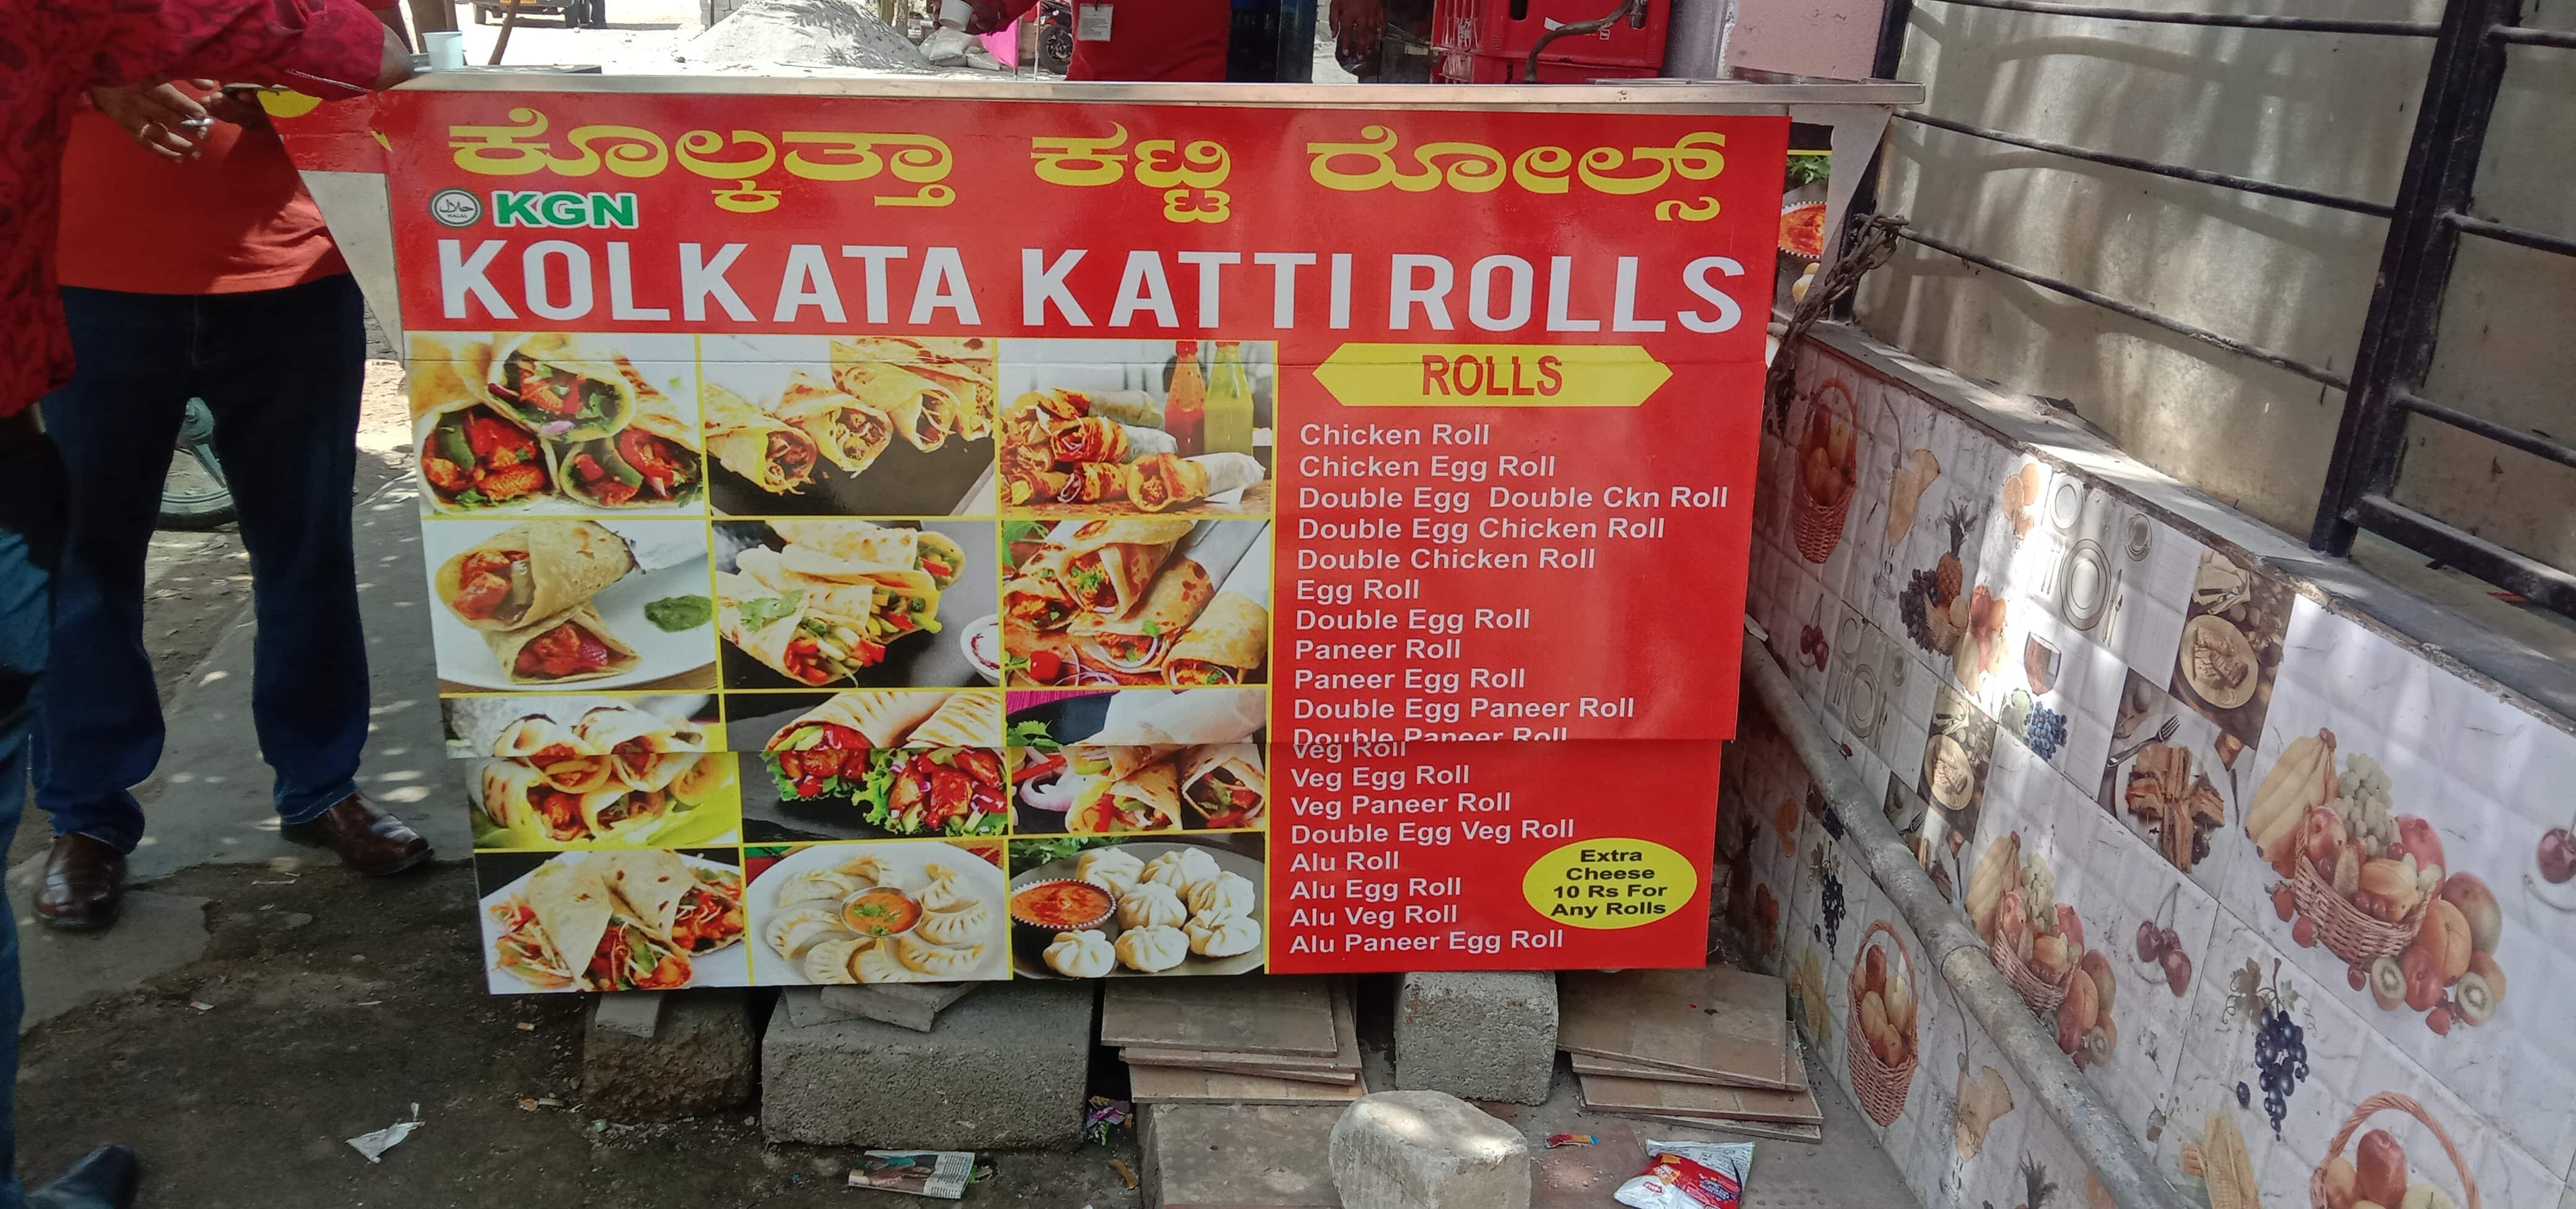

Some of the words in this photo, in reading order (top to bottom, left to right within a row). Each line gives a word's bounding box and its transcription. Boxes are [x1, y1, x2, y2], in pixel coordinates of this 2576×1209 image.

[1030, 121, 1231, 224] ಕಟ್ಟಿ
[1307, 125, 1726, 222] ರೋಲ್ಸ್
[494, 191, 637, 228] KGN
[438, 239, 981, 325] KOLKATA
[1022, 248, 1352, 329] KATTI
[1389, 254, 1745, 333] ROLLS
[1421, 354, 1562, 396] ROLLS
[1300, 424, 1421, 445] Chicken
[1432, 424, 1489, 445] Roll
[1300, 455, 1419, 477] Chicken
[1431, 455, 1487, 482] Egg
[1499, 455, 1555, 477] Roll
[1299, 487, 1403, 508] Double
[1414, 487, 1469, 513] Egg
[1490, 486, 1593, 508] Double
[1603, 486, 1660, 508] Ckn
[1671, 486, 1728, 508] Roll
[1299, 518, 1401, 539] Double
[1412, 518, 1468, 544] Egg
[1479, 517, 1597, 538] Chicken
[1608, 517, 1664, 538] Roll
[1298, 549, 1400, 570] Double
[1411, 548, 1528, 569] Chicken
[1539, 548, 1595, 569] Roll
[1297, 579, 1352, 605] Egg
[1364, 578, 1419, 600] Roll
[1297, 609, 1398, 630] Double
[1409, 609, 1464, 634] Egg
[1475, 608, 1530, 629] Roll
[1295, 640, 1397, 660] Paneer
[1406, 639, 1460, 659] Roll
[1295, 670, 1396, 689] Paneer
[1405, 668, 1460, 694] Egg
[1470, 668, 1525, 688] Roll
[1294, 698, 1395, 719] Double
[1405, 698, 1460, 723] Egg
[1471, 697, 1571, 718] Paneer
[1579, 697, 1634, 718] Roll
[1292, 743, 1342, 764] Veg
[1353, 741, 1406, 757] Roll
[1290, 768, 1342, 792] Veg
[1353, 767, 1406, 791] Egg
[1416, 764, 1469, 785] Roll
[1290, 797, 1341, 820] Veg
[1352, 795, 1449, 814] Paneer
[1458, 792, 1510, 812] Roll
[1292, 823, 1388, 844] Double
[1399, 822, 1451, 846] Egg
[1461, 821, 1511, 844] Veg
[1521, 819, 1573, 839] Roll
[1290, 852, 1336, 872] Alu
[1347, 850, 1399, 871] Roll
[1580, 849, 1642, 863] Extra
[1566, 867, 1655, 881] Cheese
[1290, 881, 1335, 900] Alu
[1346, 879, 1398, 902] Egg
[1409, 876, 1461, 896] Roll
[1554, 886, 1580, 899] 10
[1588, 885, 1619, 898] Rs
[1627, 884, 1668, 897] For
[1289, 908, 1334, 927] Alu
[1344, 906, 1395, 929] Veg
[1405, 904, 1457, 923] Roll
[1551, 904, 1598, 919] Any
[1606, 901, 1666, 915] Rolls
[1289, 935, 1334, 954] Alu
[1345, 934, 1440, 952] Paneer
[1449, 931, 1501, 954] Egg
[1511, 929, 1563, 948] Roll
